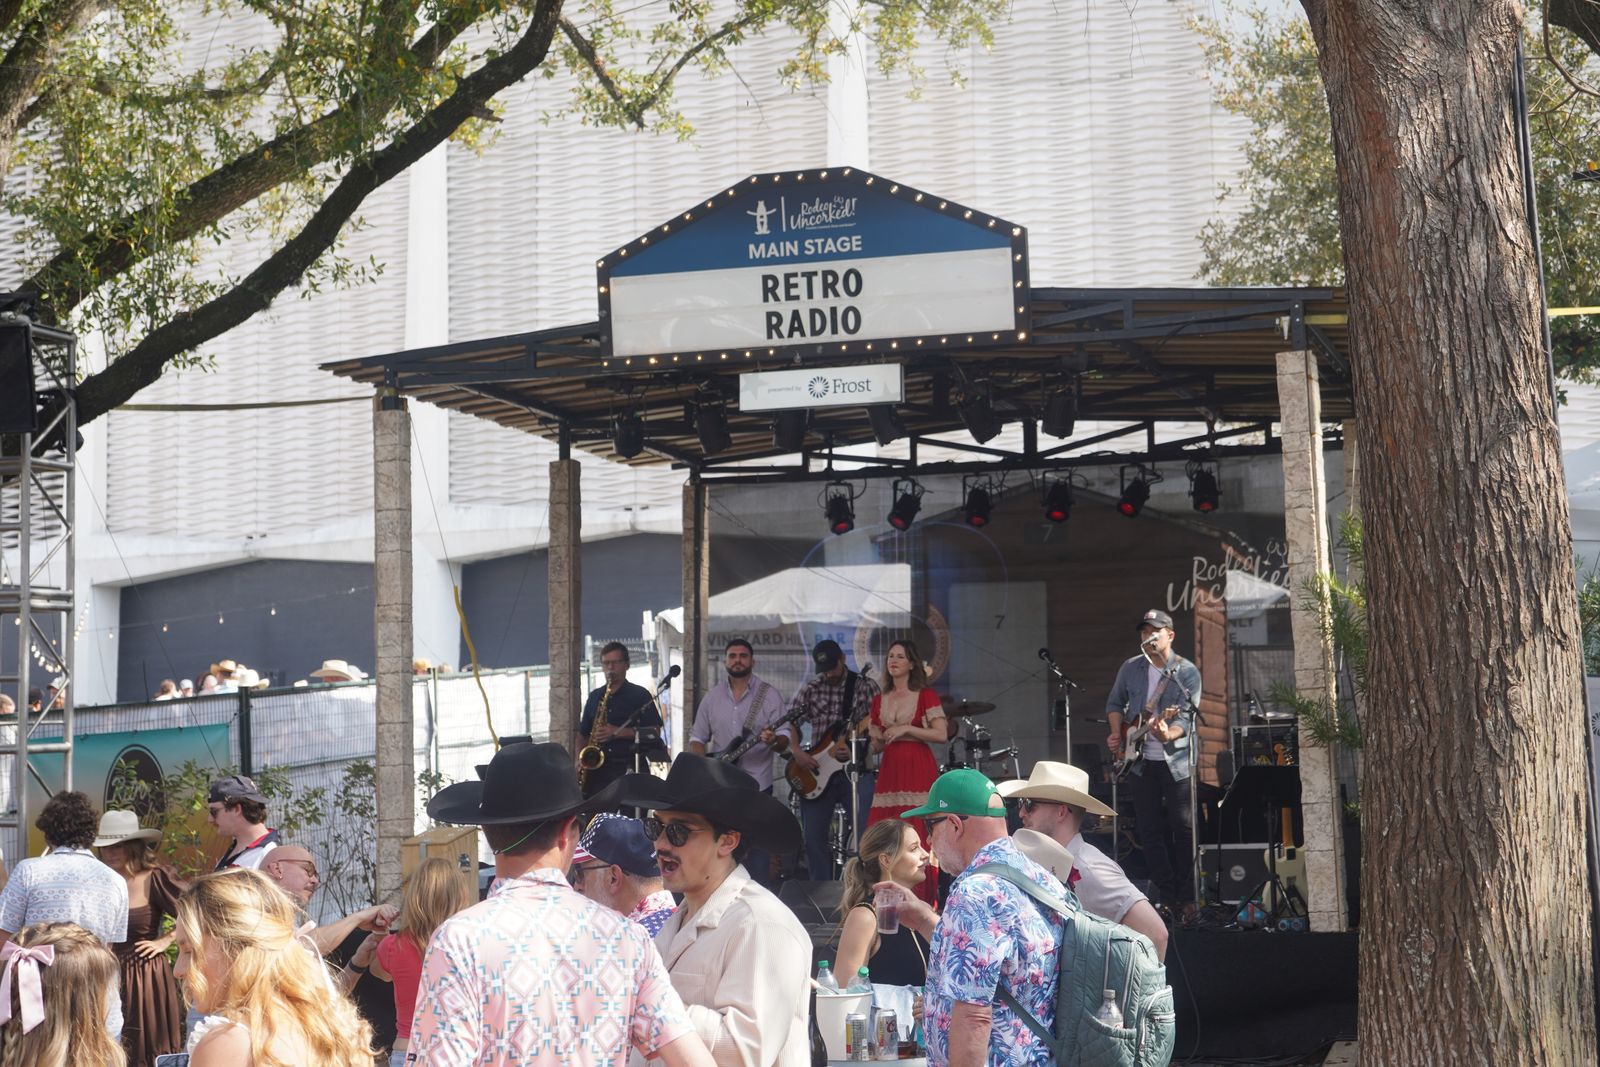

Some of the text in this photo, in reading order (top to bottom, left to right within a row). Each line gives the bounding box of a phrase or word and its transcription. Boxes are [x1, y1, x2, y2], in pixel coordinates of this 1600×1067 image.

[801, 197, 829, 216] Rodeo
[748, 235, 862, 259] MAIN STAGE
[761, 267, 863, 303] RETRO
[765, 305, 862, 340] RADIO
[832, 378, 871, 394] Frost
[1042, 524, 1054, 542] 7
[1192, 546, 1254, 586] Rodeo
[995, 615, 1005, 630] 7
